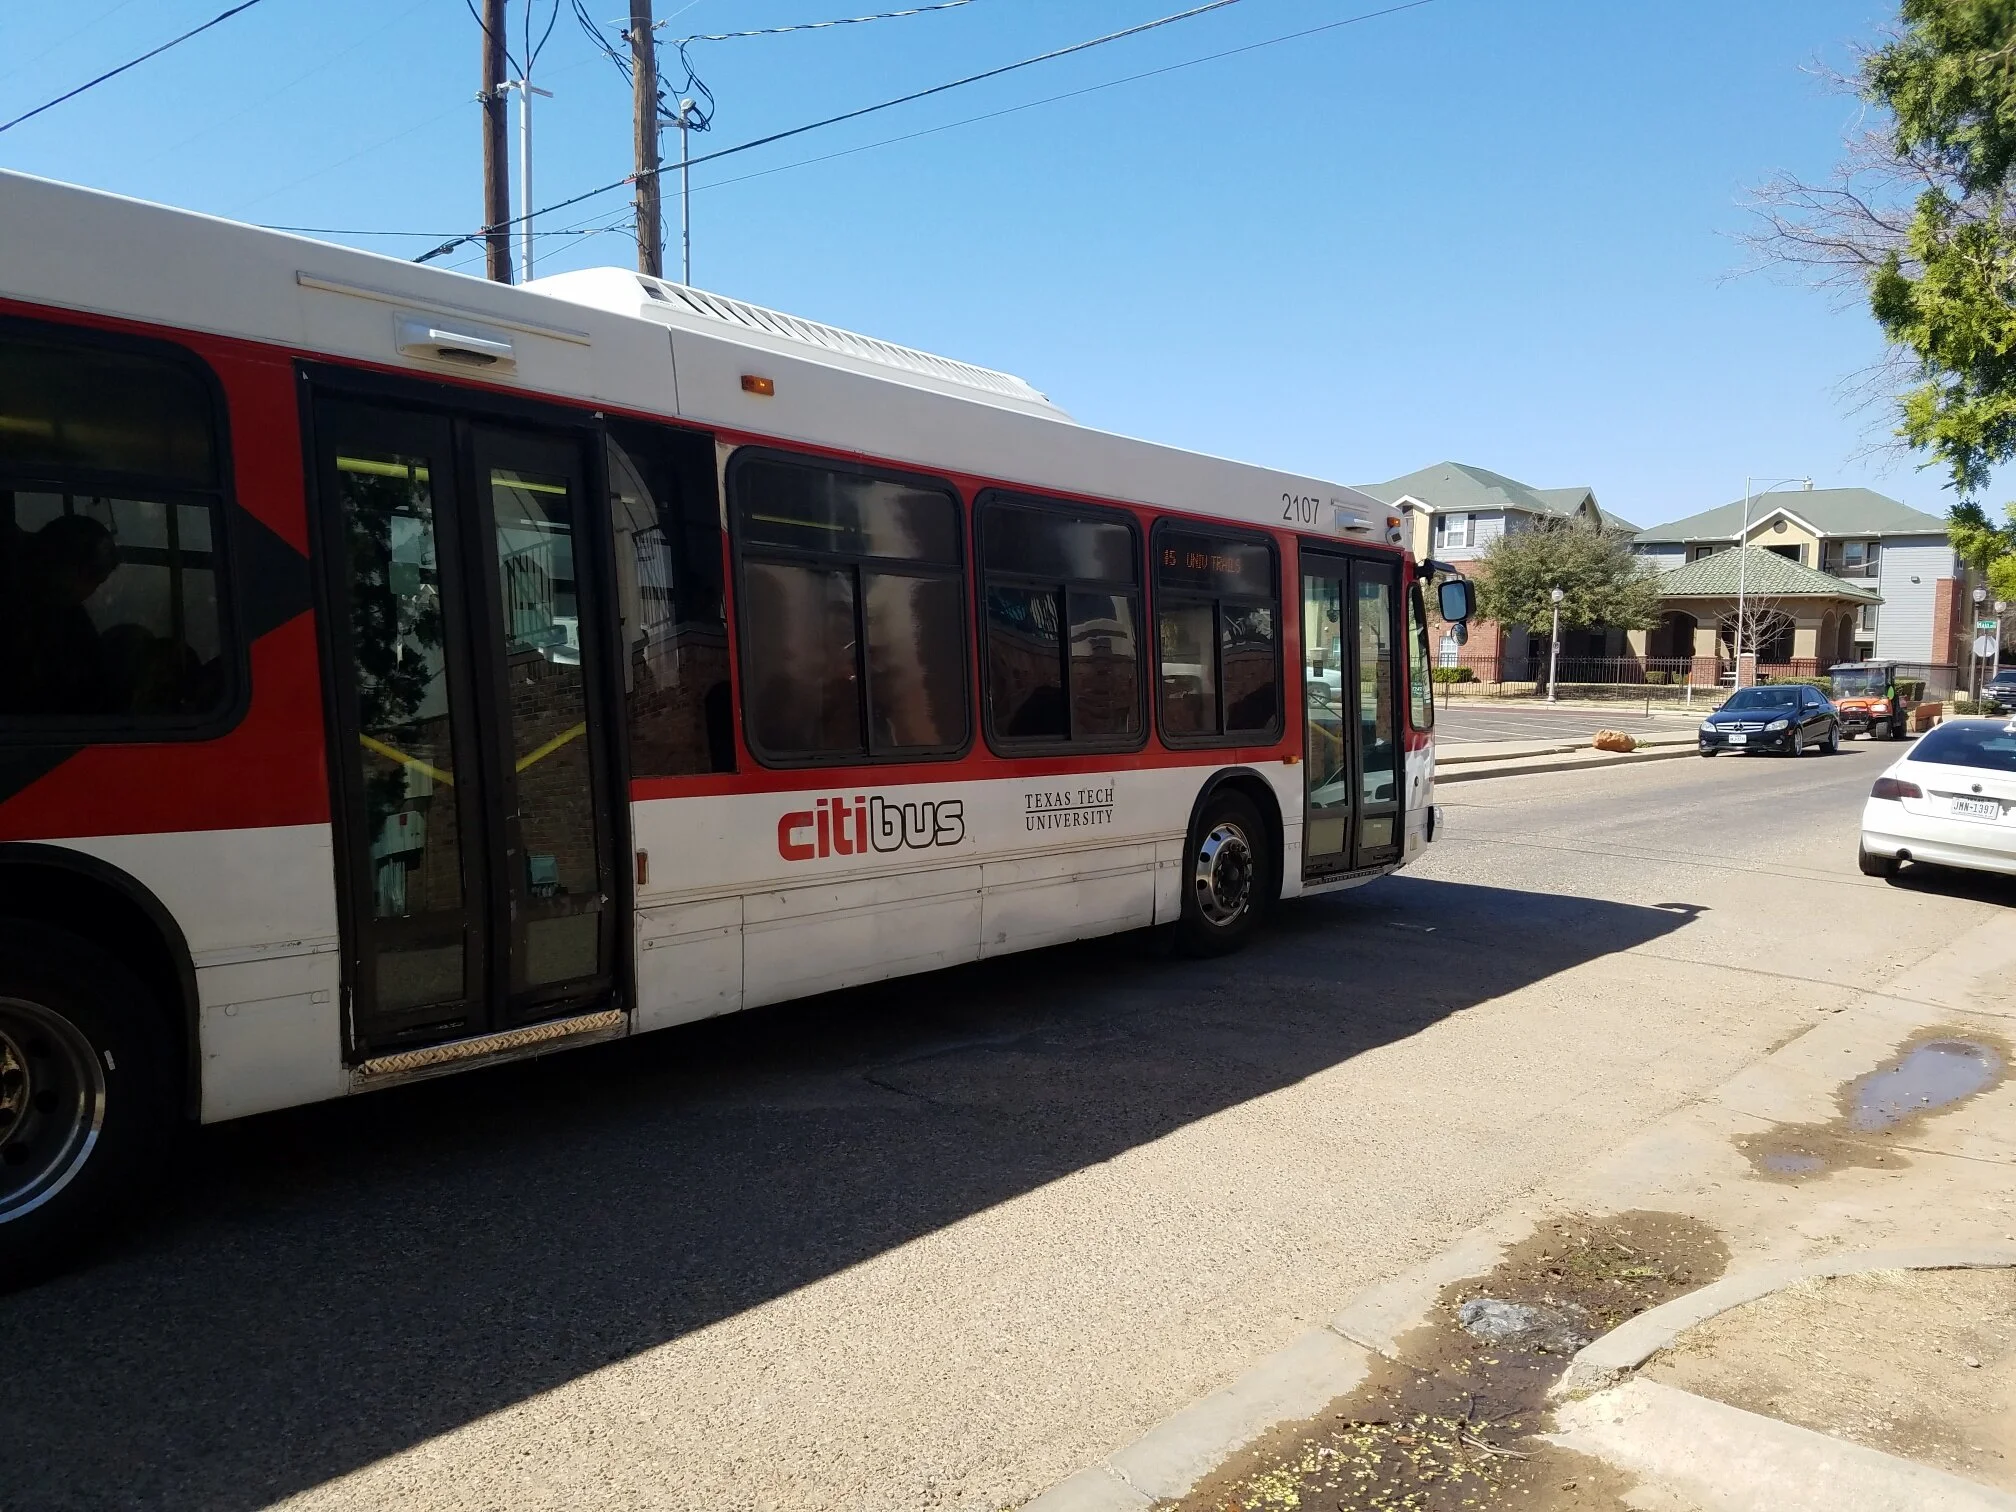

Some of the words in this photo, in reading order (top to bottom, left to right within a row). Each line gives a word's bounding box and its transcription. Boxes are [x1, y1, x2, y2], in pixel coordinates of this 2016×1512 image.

[1282, 493, 1320, 524] 2107
[1186, 552, 1208, 569] UNIV
[1025, 791, 1071, 808] TEXAS
[1078, 788, 1114, 804] TECH
[777, 795, 965, 862] citibus
[1026, 809, 1113, 831] UNIVERSITY
